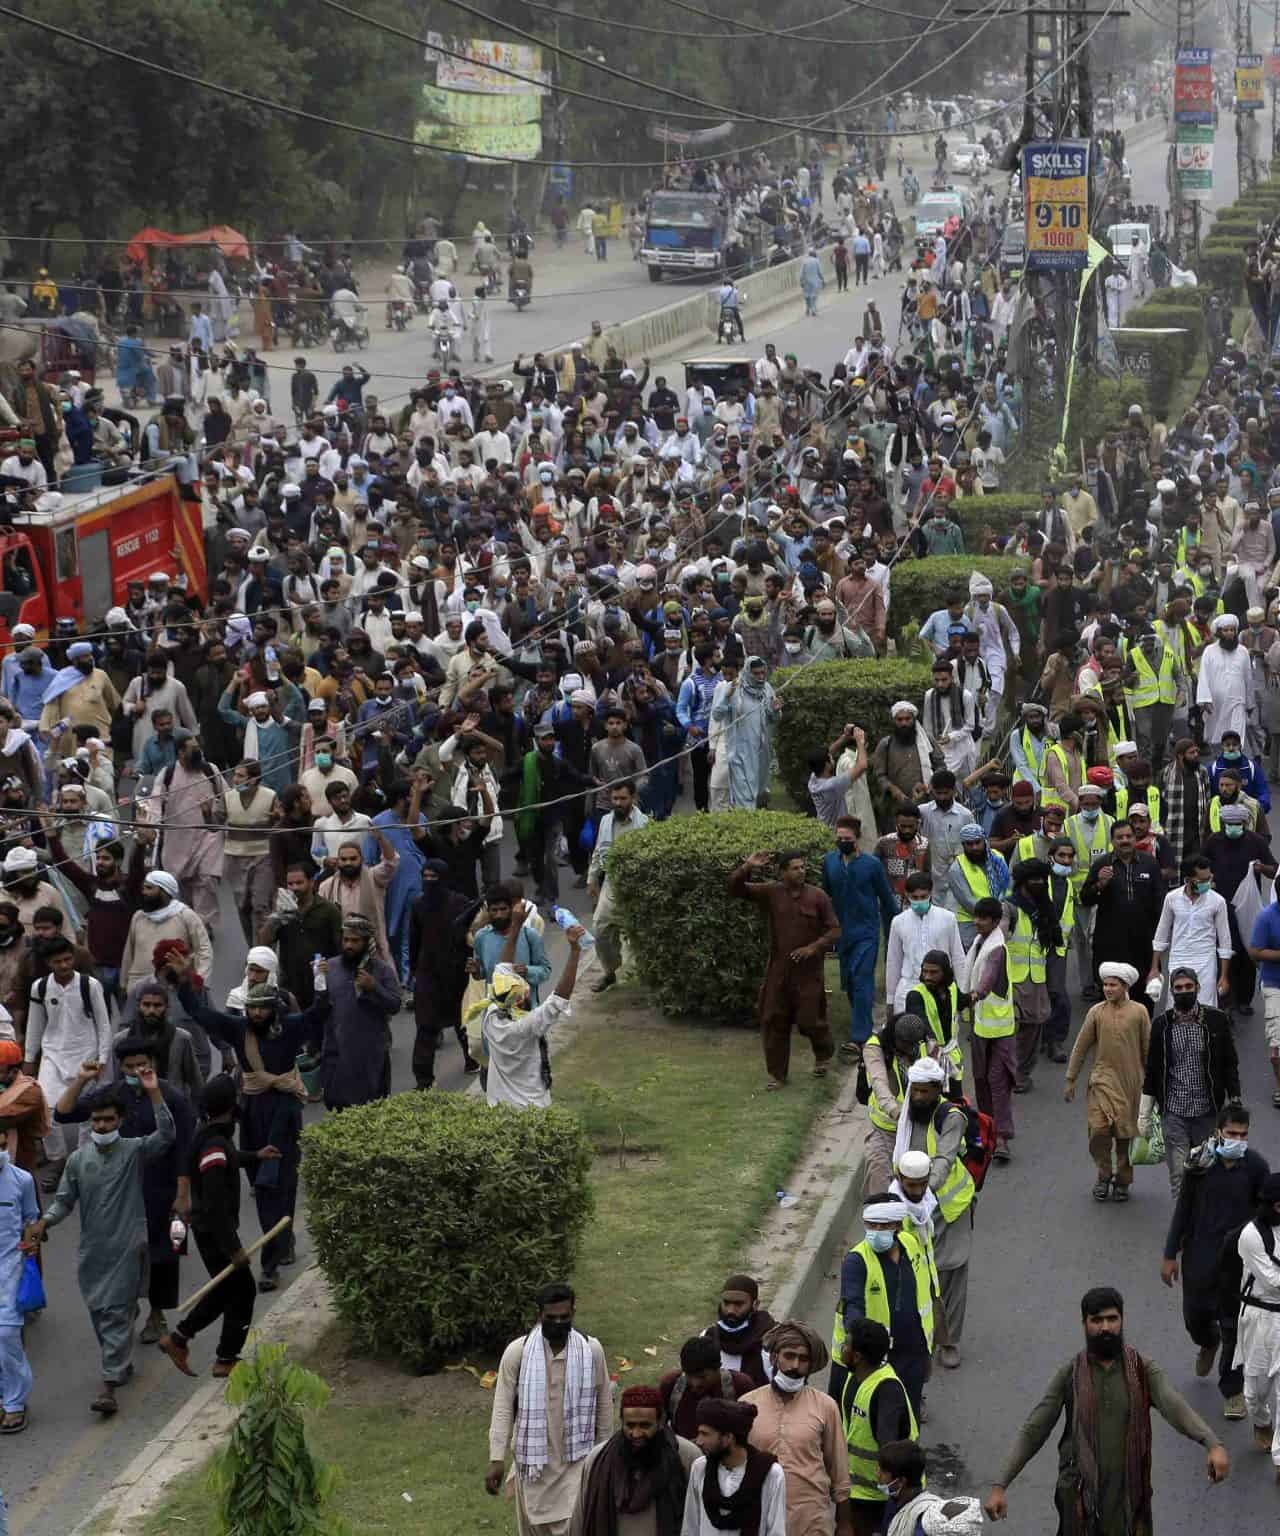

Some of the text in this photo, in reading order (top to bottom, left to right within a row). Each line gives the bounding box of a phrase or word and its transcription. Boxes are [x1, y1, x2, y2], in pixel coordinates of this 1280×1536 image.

[1032, 153, 1082, 169] SKILLS
[1035, 203, 1081, 228] 9 10
[116, 537, 140, 557] RESCUE
